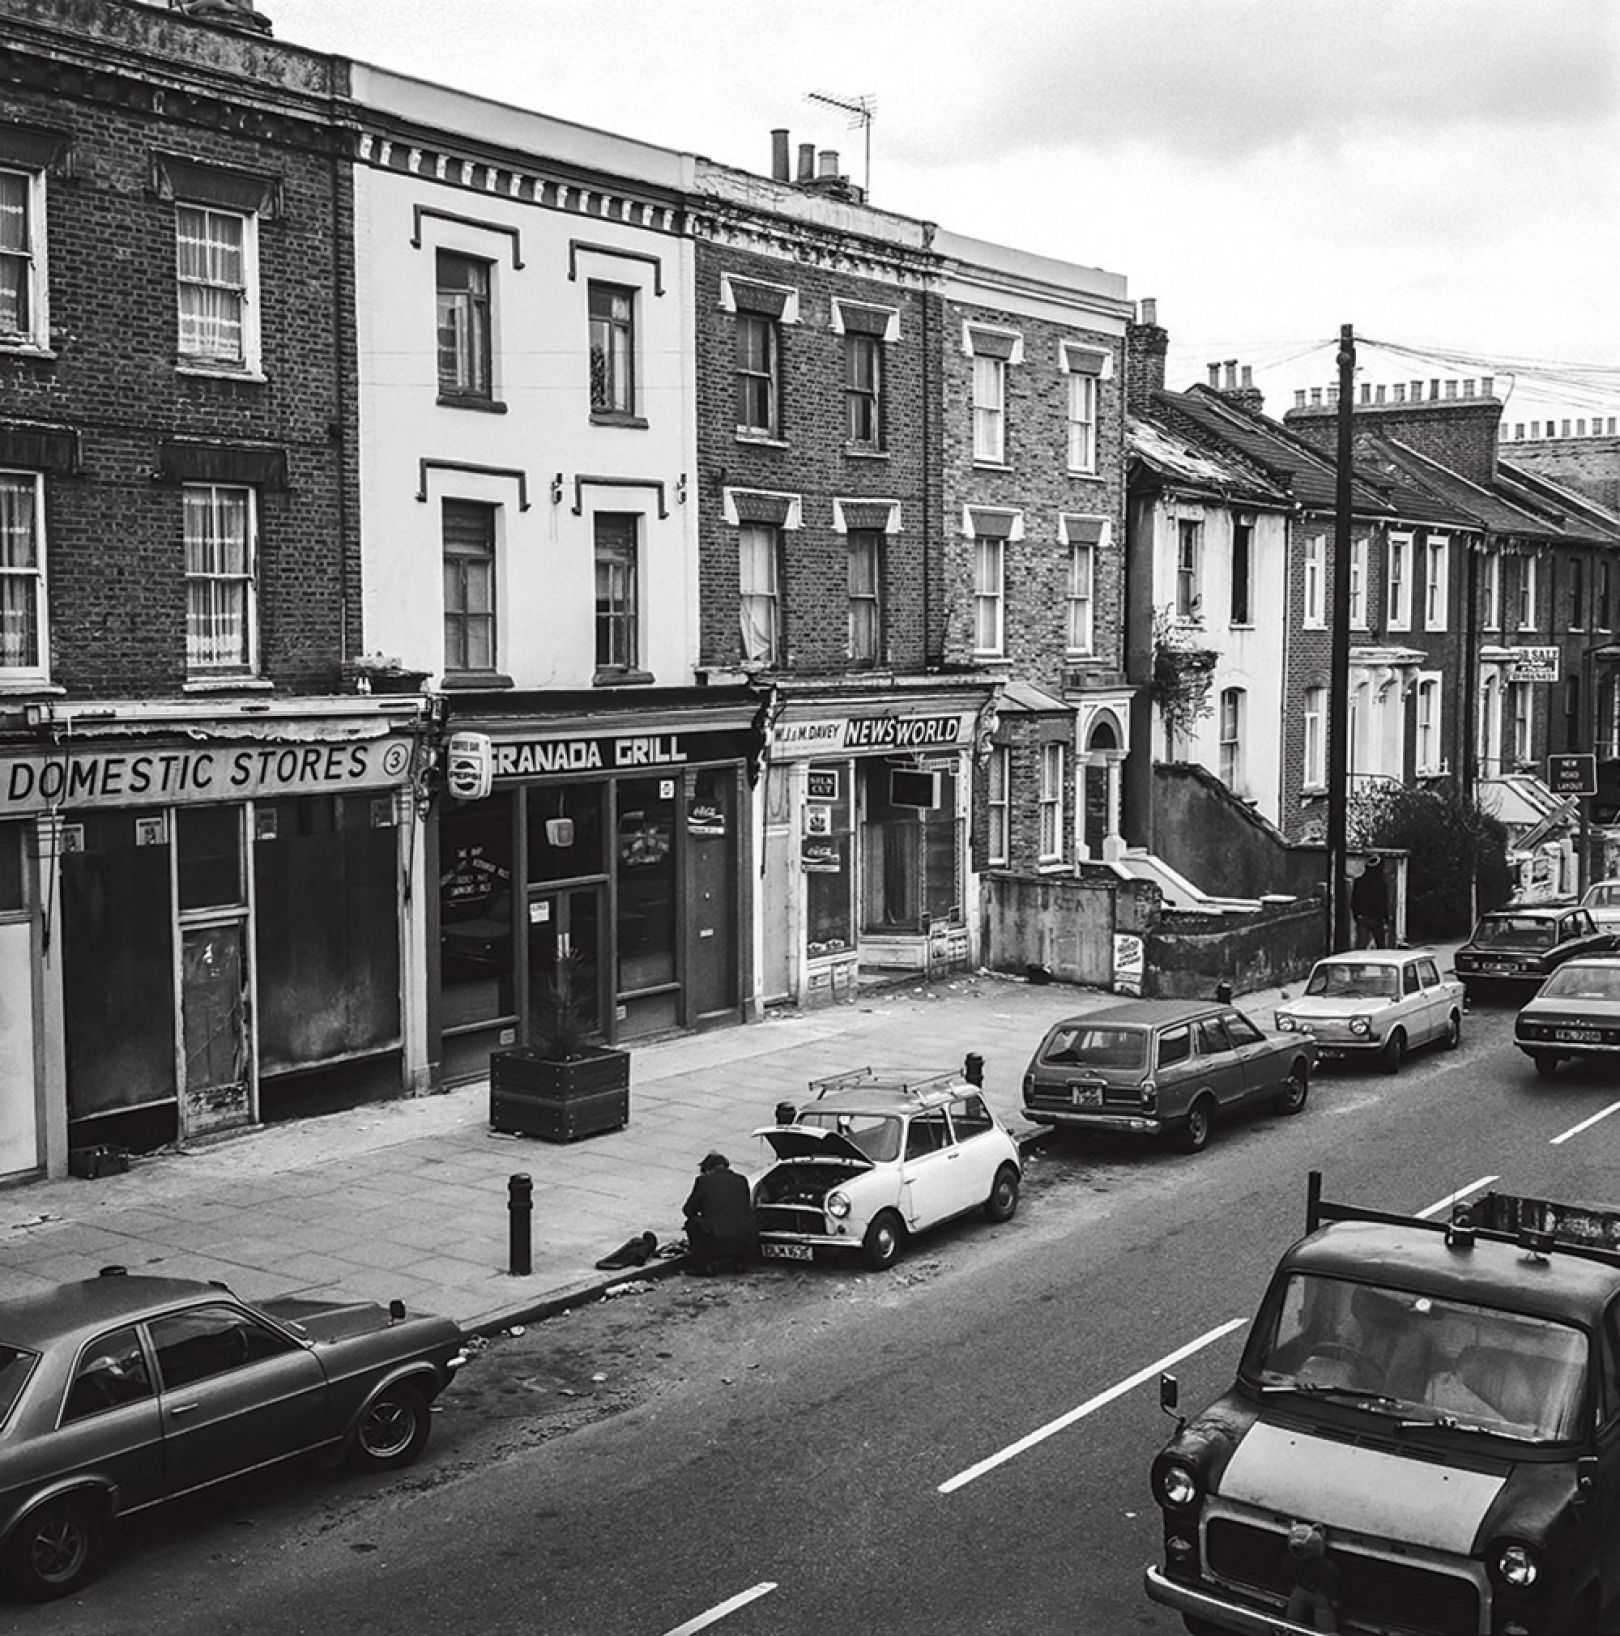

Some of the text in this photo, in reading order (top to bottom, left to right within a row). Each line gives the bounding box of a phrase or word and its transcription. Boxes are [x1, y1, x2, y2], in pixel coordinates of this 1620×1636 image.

[846, 718, 958, 745] NEWS WORLD
[615, 736, 688, 765] GRILL
[390, 751, 401, 769] 3
[8, 745, 369, 801] DOMESTIC STORES
[449, 770, 481, 780] PEPSI
[1560, 770, 1580, 779] ROAD
[809, 776, 834, 785] SILK
[811, 785, 832, 794] CUT
[1556, 782, 1584, 790] LAYOUT
